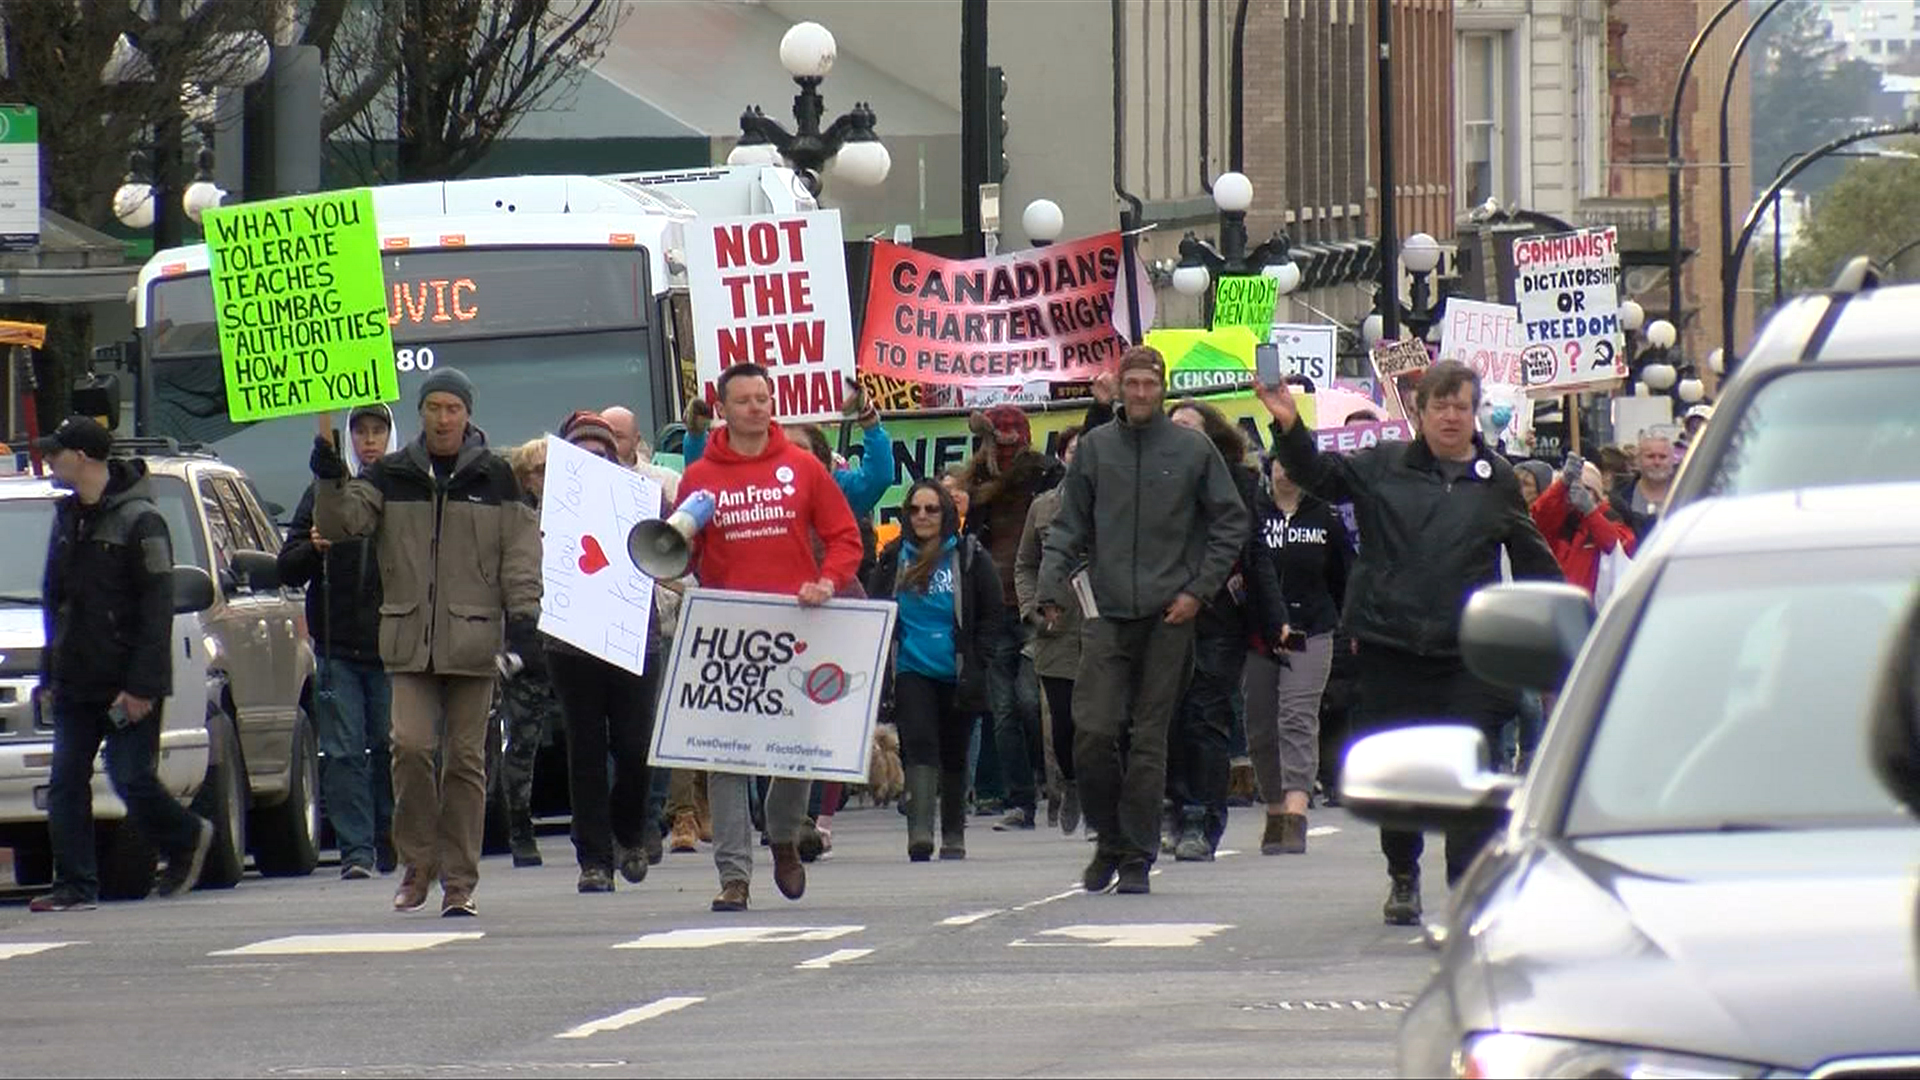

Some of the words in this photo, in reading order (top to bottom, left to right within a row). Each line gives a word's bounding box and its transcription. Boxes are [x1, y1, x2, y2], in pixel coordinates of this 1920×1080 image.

[216, 208, 293, 243] WHAT
[304, 200, 360, 231] YOU
[216, 232, 338, 272] TOLERATE
[713, 219, 808, 269] NOT
[1516, 231, 1617, 267] COMMUNIST
[220, 262, 334, 300] TEACHES
[722, 271, 814, 320] THE
[892, 246, 1117, 306] CANADIANS
[1523, 267, 1621, 293] DICTATORSHIP
[223, 289, 342, 330] SCUMBAG
[895, 304, 1046, 345] CHARTER
[1048, 291, 1115, 340] RIGH
[1557, 291, 1585, 313] OR
[717, 320, 826, 371] NEW
[1526, 314, 1619, 342] FREEDOM
[235, 355, 288, 385] HOW
[293, 348, 329, 375] TO
[874, 339, 908, 369] TO
[917, 343, 1057, 378] PEACEFUL
[239, 378, 313, 412] TREAT
[321, 358, 381, 401] YOU!
[1317, 426, 1402, 451] FEAR
[718, 490, 745, 508] Am
[747, 484, 783, 504] Free
[690, 626, 796, 665] HUGS
[701, 660, 777, 688] over
